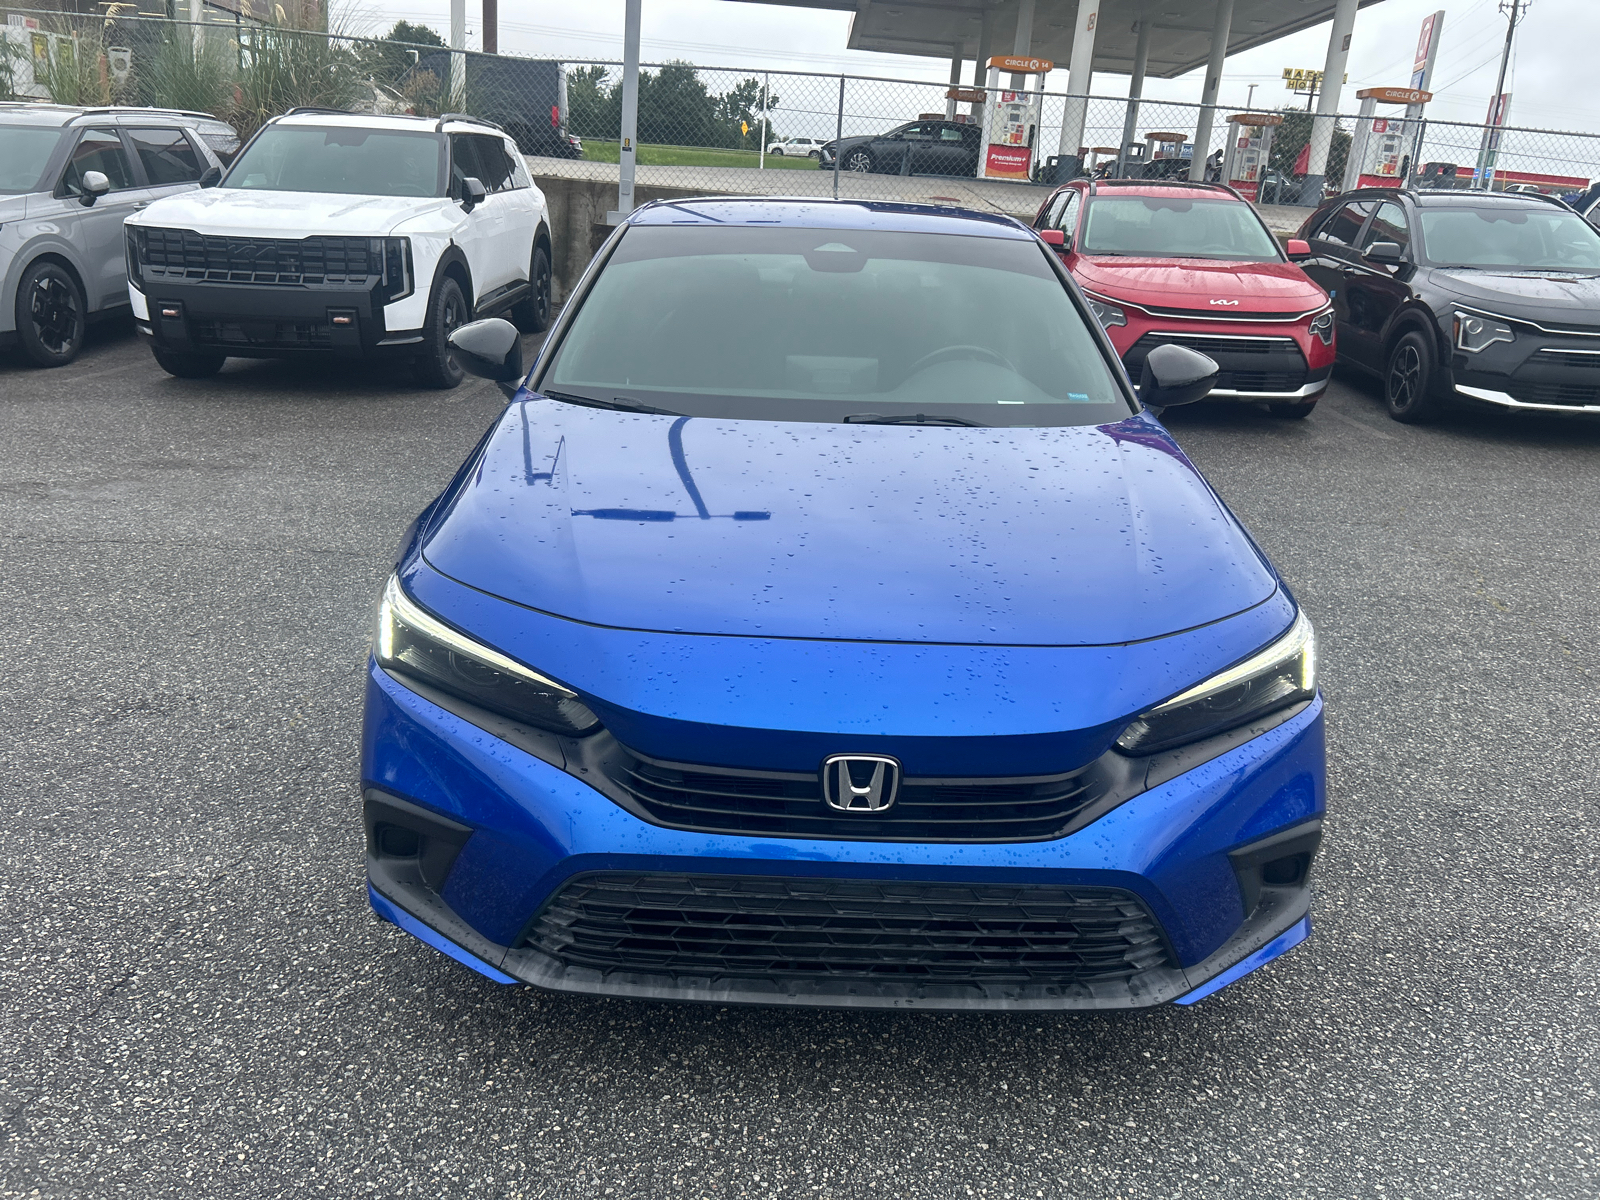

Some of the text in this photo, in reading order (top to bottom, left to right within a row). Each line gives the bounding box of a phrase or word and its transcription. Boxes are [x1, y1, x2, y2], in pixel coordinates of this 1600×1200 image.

[1005, 59, 1028, 67] CIRCLE
[1029, 60, 1039, 69] K
[1385, 90, 1410, 99] CIRCLE
[1410, 91, 1420, 101] K
